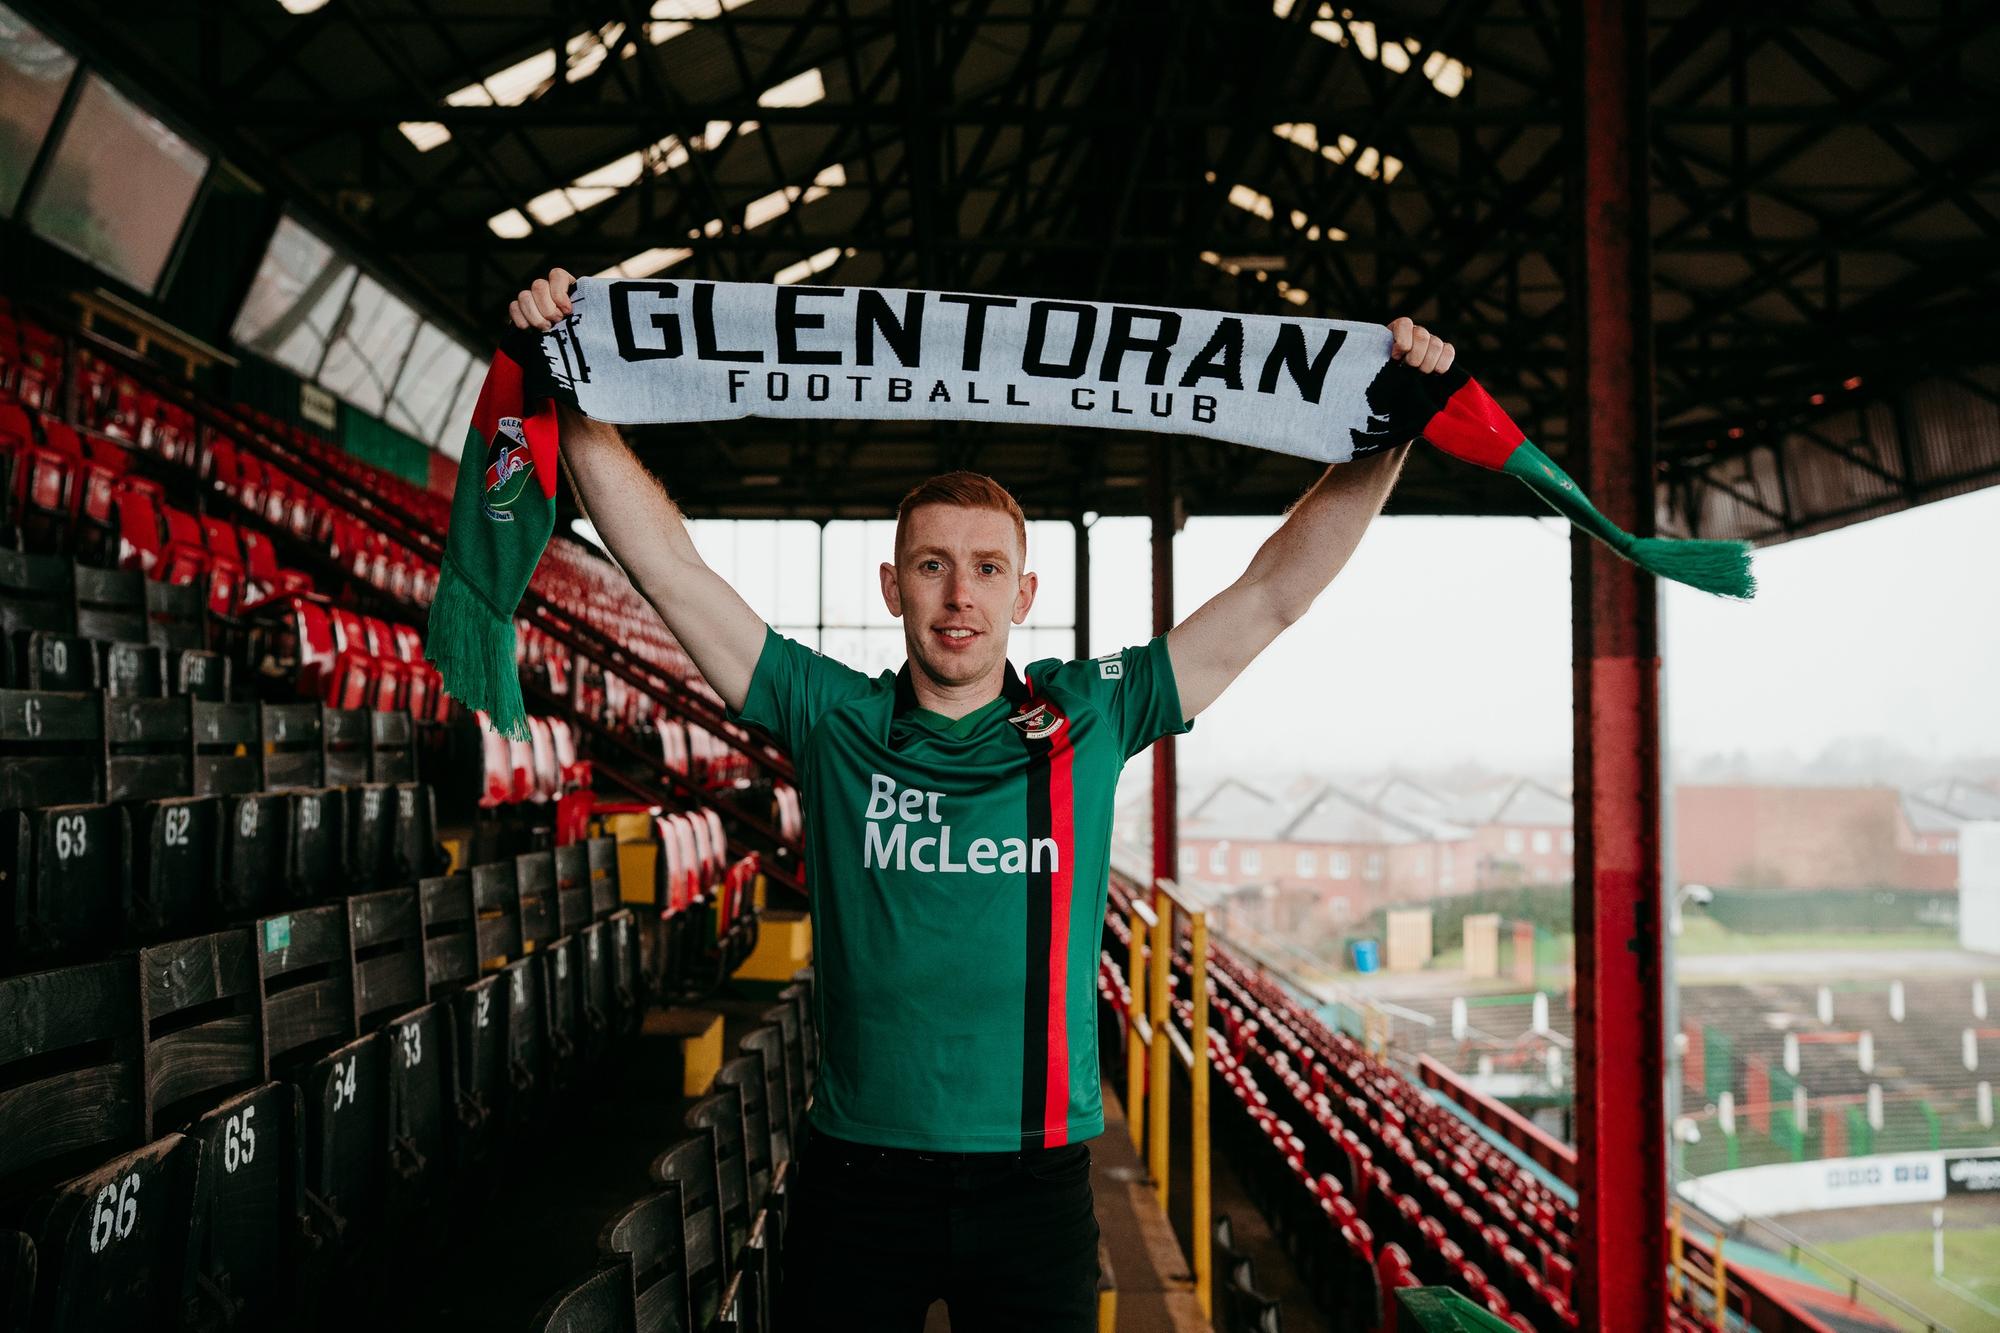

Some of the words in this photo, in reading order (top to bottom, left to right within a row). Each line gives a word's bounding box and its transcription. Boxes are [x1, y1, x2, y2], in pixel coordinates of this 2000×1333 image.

[608, 281, 1348, 405] GLENTORAN
[728, 370, 1030, 406] FOOTBALL
[1071, 387, 1218, 424] CLUB
[25, 699, 42, 738] 6
[864, 774, 947, 824] Bet
[56, 815, 86, 859] 63
[165, 807, 190, 846] 62
[863, 821, 1060, 874] McLean
[224, 1105, 255, 1173] 65
[90, 1172, 141, 1253] 66
